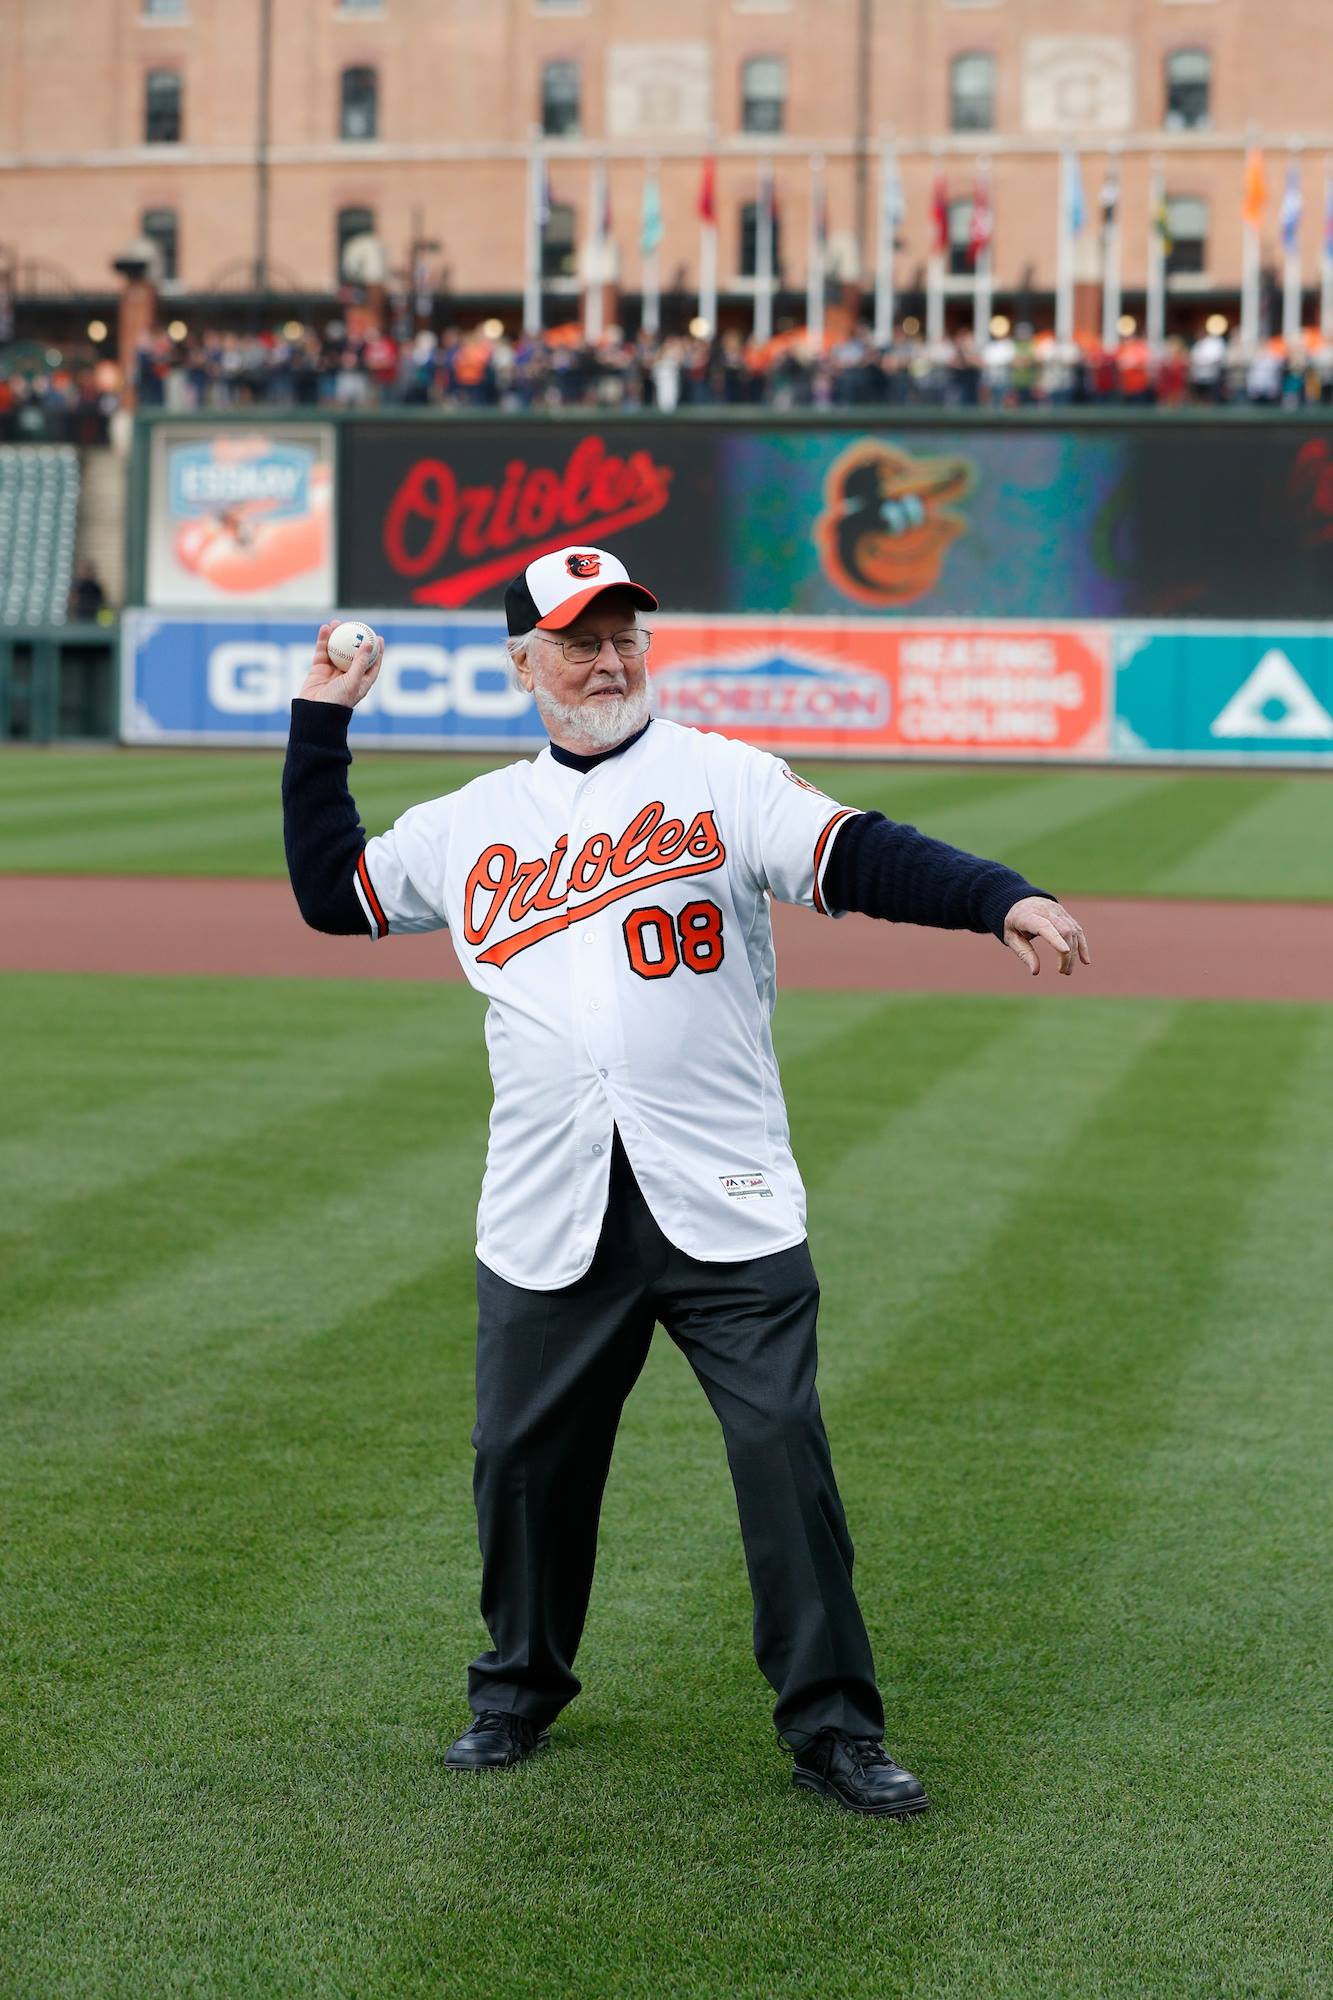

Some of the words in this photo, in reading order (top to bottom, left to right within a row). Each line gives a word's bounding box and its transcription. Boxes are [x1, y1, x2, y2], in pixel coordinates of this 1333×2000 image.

[383, 434, 672, 577] Orioles
[208, 641, 531, 719] GCO
[658, 684, 878, 716] HORIZON
[464, 800, 725, 947] Orioles
[622, 899, 725, 980] 08
